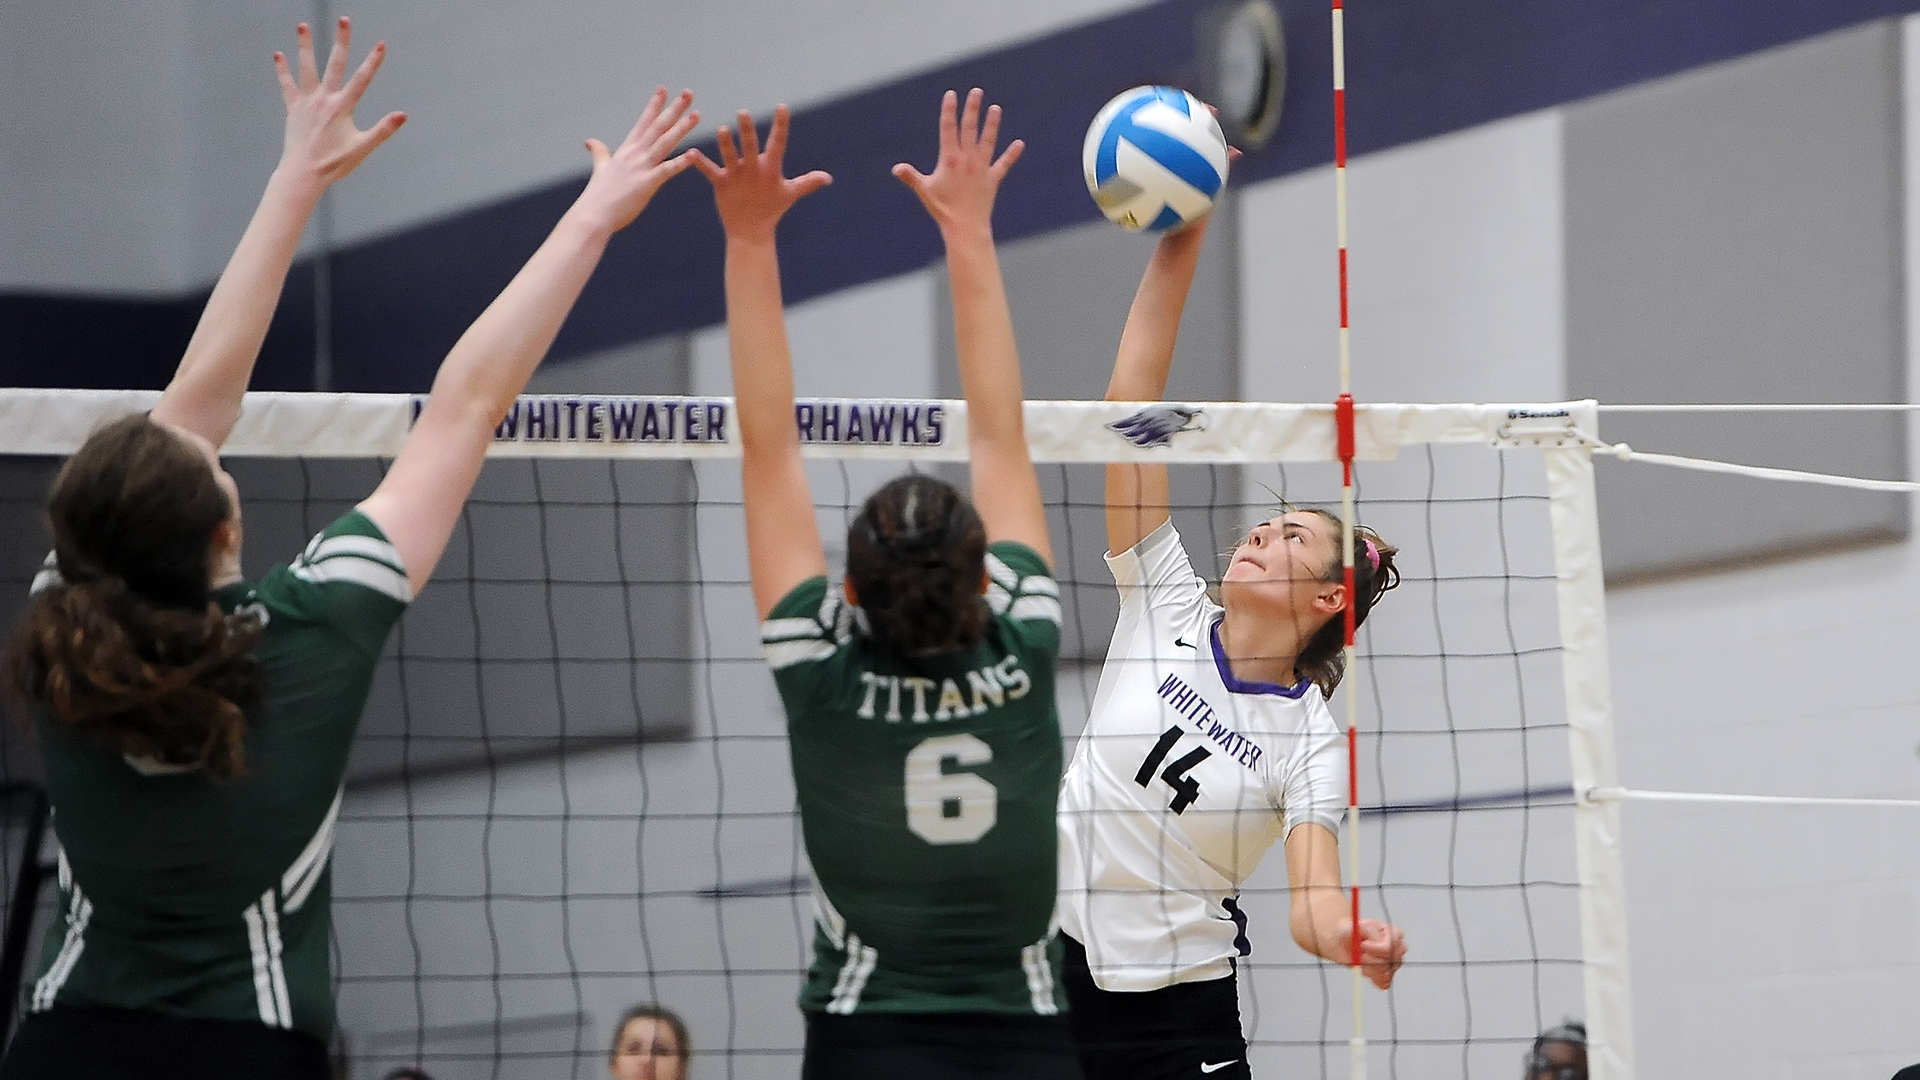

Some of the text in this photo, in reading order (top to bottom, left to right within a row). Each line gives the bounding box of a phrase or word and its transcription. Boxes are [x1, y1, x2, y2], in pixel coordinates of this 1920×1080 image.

[494, 401, 944, 445] WHITEWATER RHAWKS
[857, 654, 1032, 723] TITANS
[1157, 672, 1263, 772] WHITEWATER
[905, 733, 999, 846] 6
[1134, 724, 1213, 816] 14
